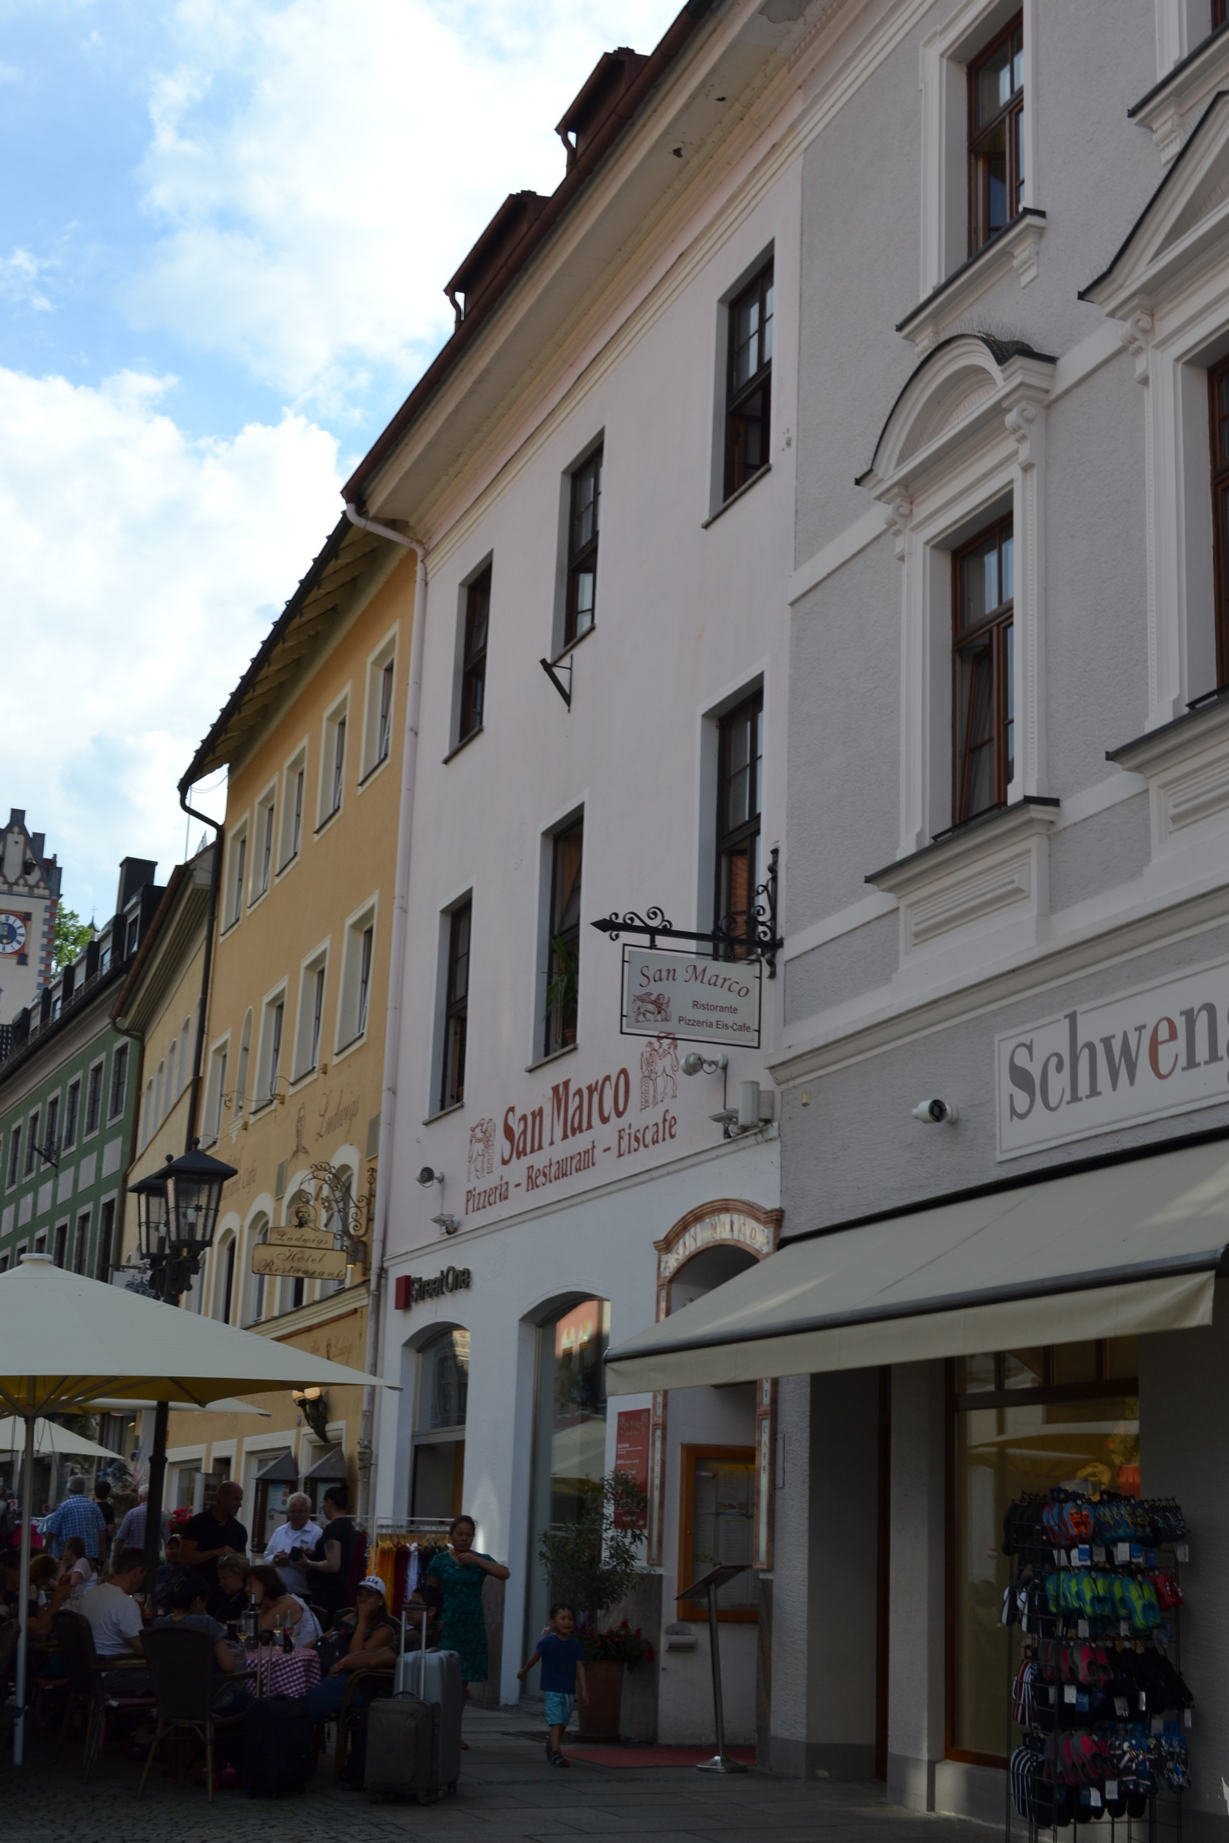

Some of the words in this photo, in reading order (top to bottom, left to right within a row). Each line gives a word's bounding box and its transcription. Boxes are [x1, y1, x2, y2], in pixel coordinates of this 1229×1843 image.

[639, 965, 677, 988] San
[683, 964, 750, 998] Marco
[692, 1000, 738, 1014] Ristorante
[678, 1016, 713, 1029] Pizzeria
[716, 1020, 751, 1033] Eis-Cafe
[1008, 1001, 1229, 1123] Schwen
[501, 1105, 544, 1166] San
[549, 1067, 630, 1147] Marco
[464, 1175, 509, 1216] Pizzeria
[526, 1139, 596, 1193] Restaurant
[616, 1109, 678, 1159] Eiscafe
[275, 1230, 329, 1246] Ludwigs
[711, 1220, 757, 1241] MARCO
[276, 1249, 326, 1264] Hotel
[257, 1258, 342, 1278] Restaurant
